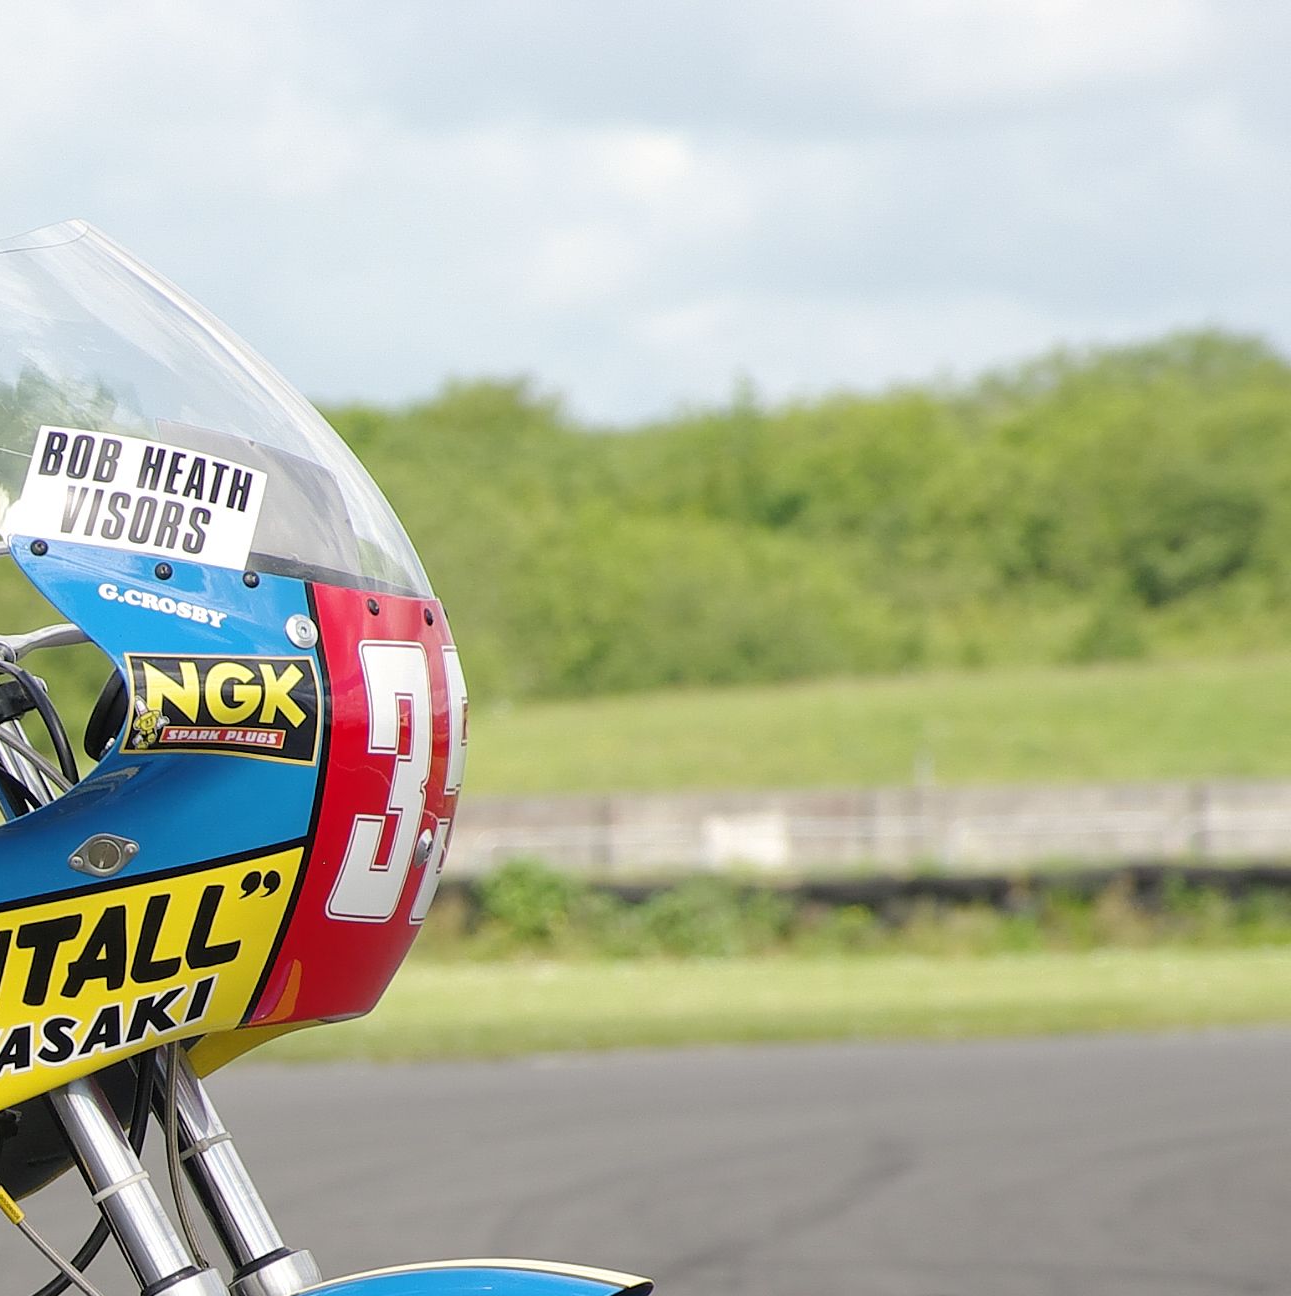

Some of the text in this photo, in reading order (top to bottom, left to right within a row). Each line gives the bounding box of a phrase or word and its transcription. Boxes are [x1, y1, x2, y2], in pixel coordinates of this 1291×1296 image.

[38, 431, 253, 512] BOB HEATH
[60, 485, 212, 555] VISORS
[98, 583, 227, 628] G.CROSBY
[142, 661, 307, 729] NGK
[166, 729, 278, 745] SPARK PLUGS
